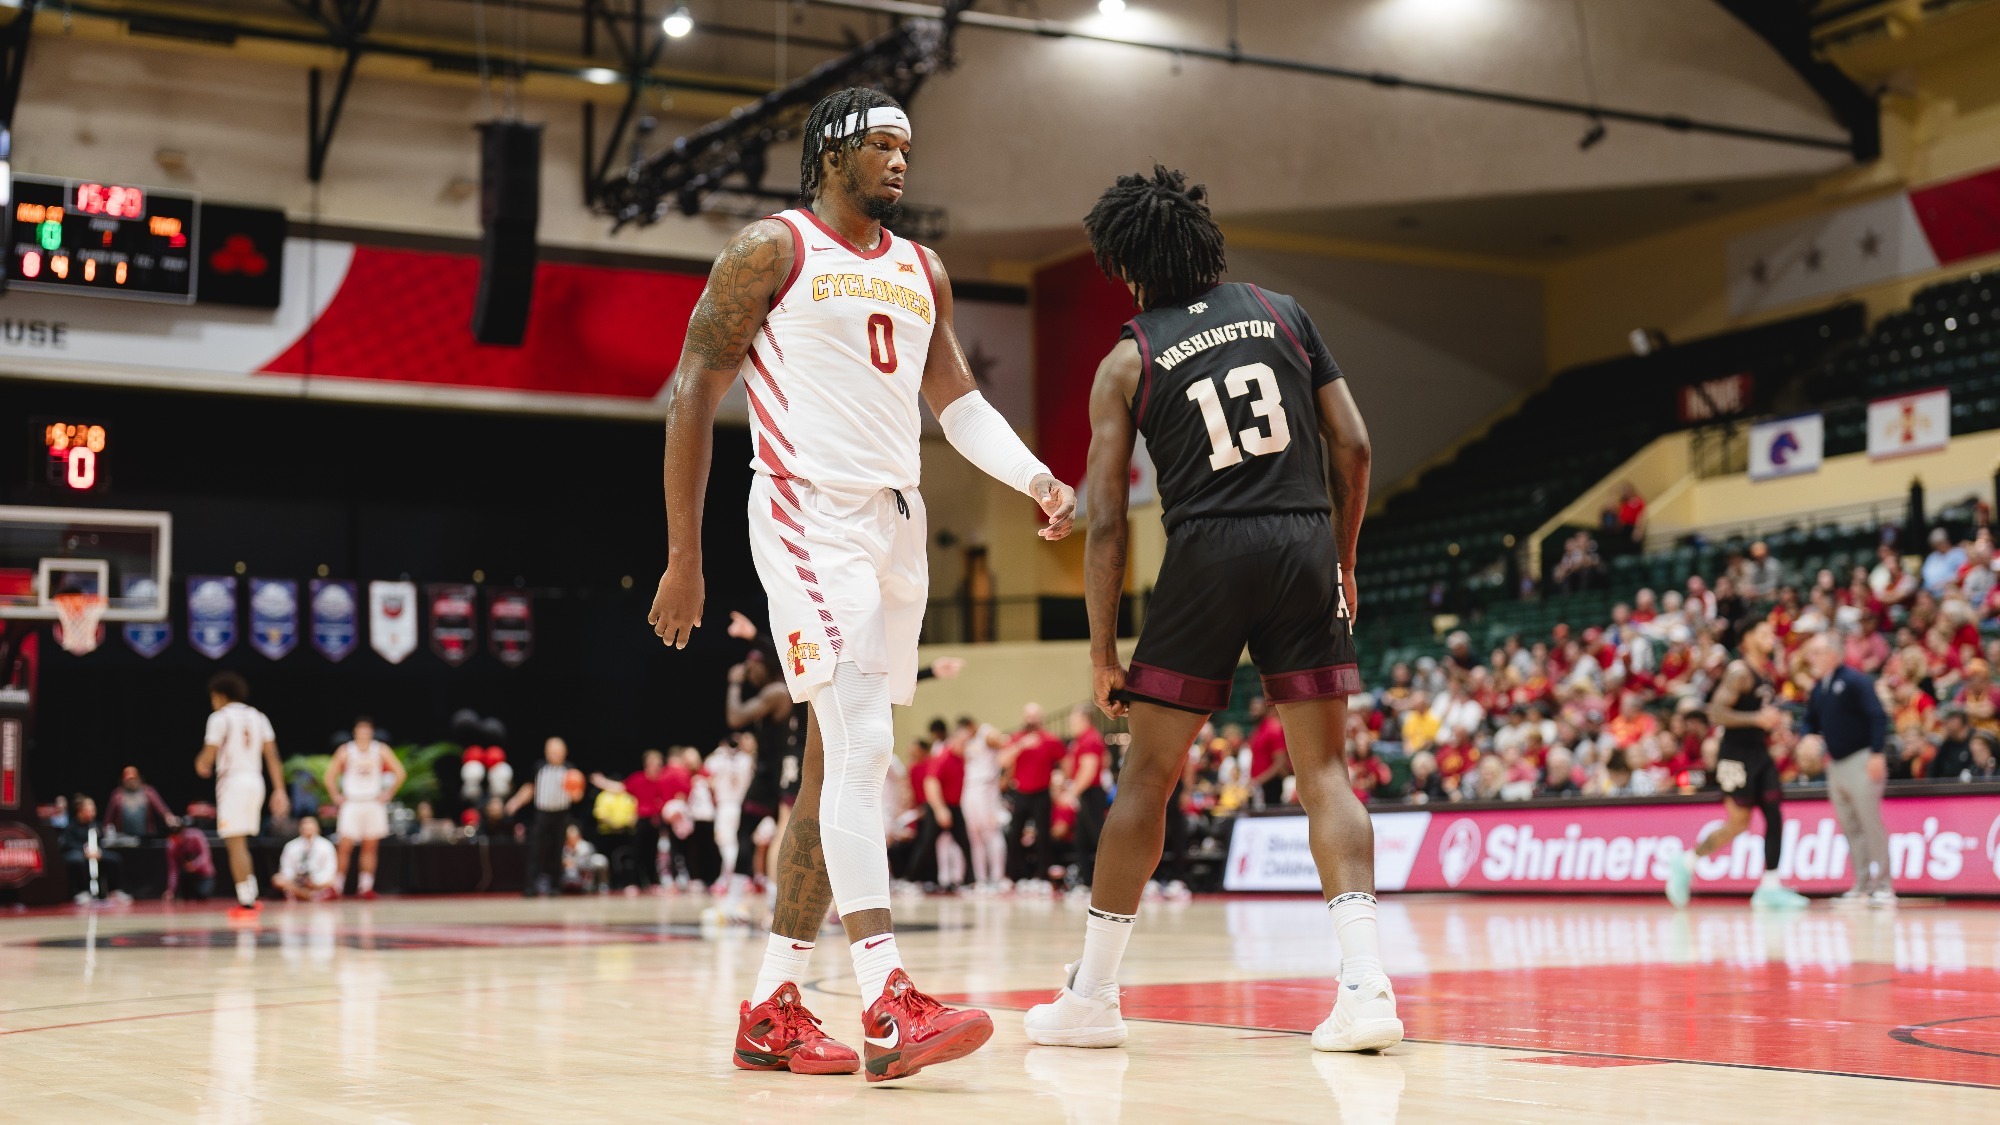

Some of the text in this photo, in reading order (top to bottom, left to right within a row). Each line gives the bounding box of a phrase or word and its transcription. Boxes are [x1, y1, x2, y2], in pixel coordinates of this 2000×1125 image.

[811, 273, 931, 325] CYCLONES
[867, 311, 898, 375] 0
[1154, 319, 1276, 371] WASHINGTON
[1185, 361, 1292, 472] 13
[1481, 822, 1685, 882] Shriners
